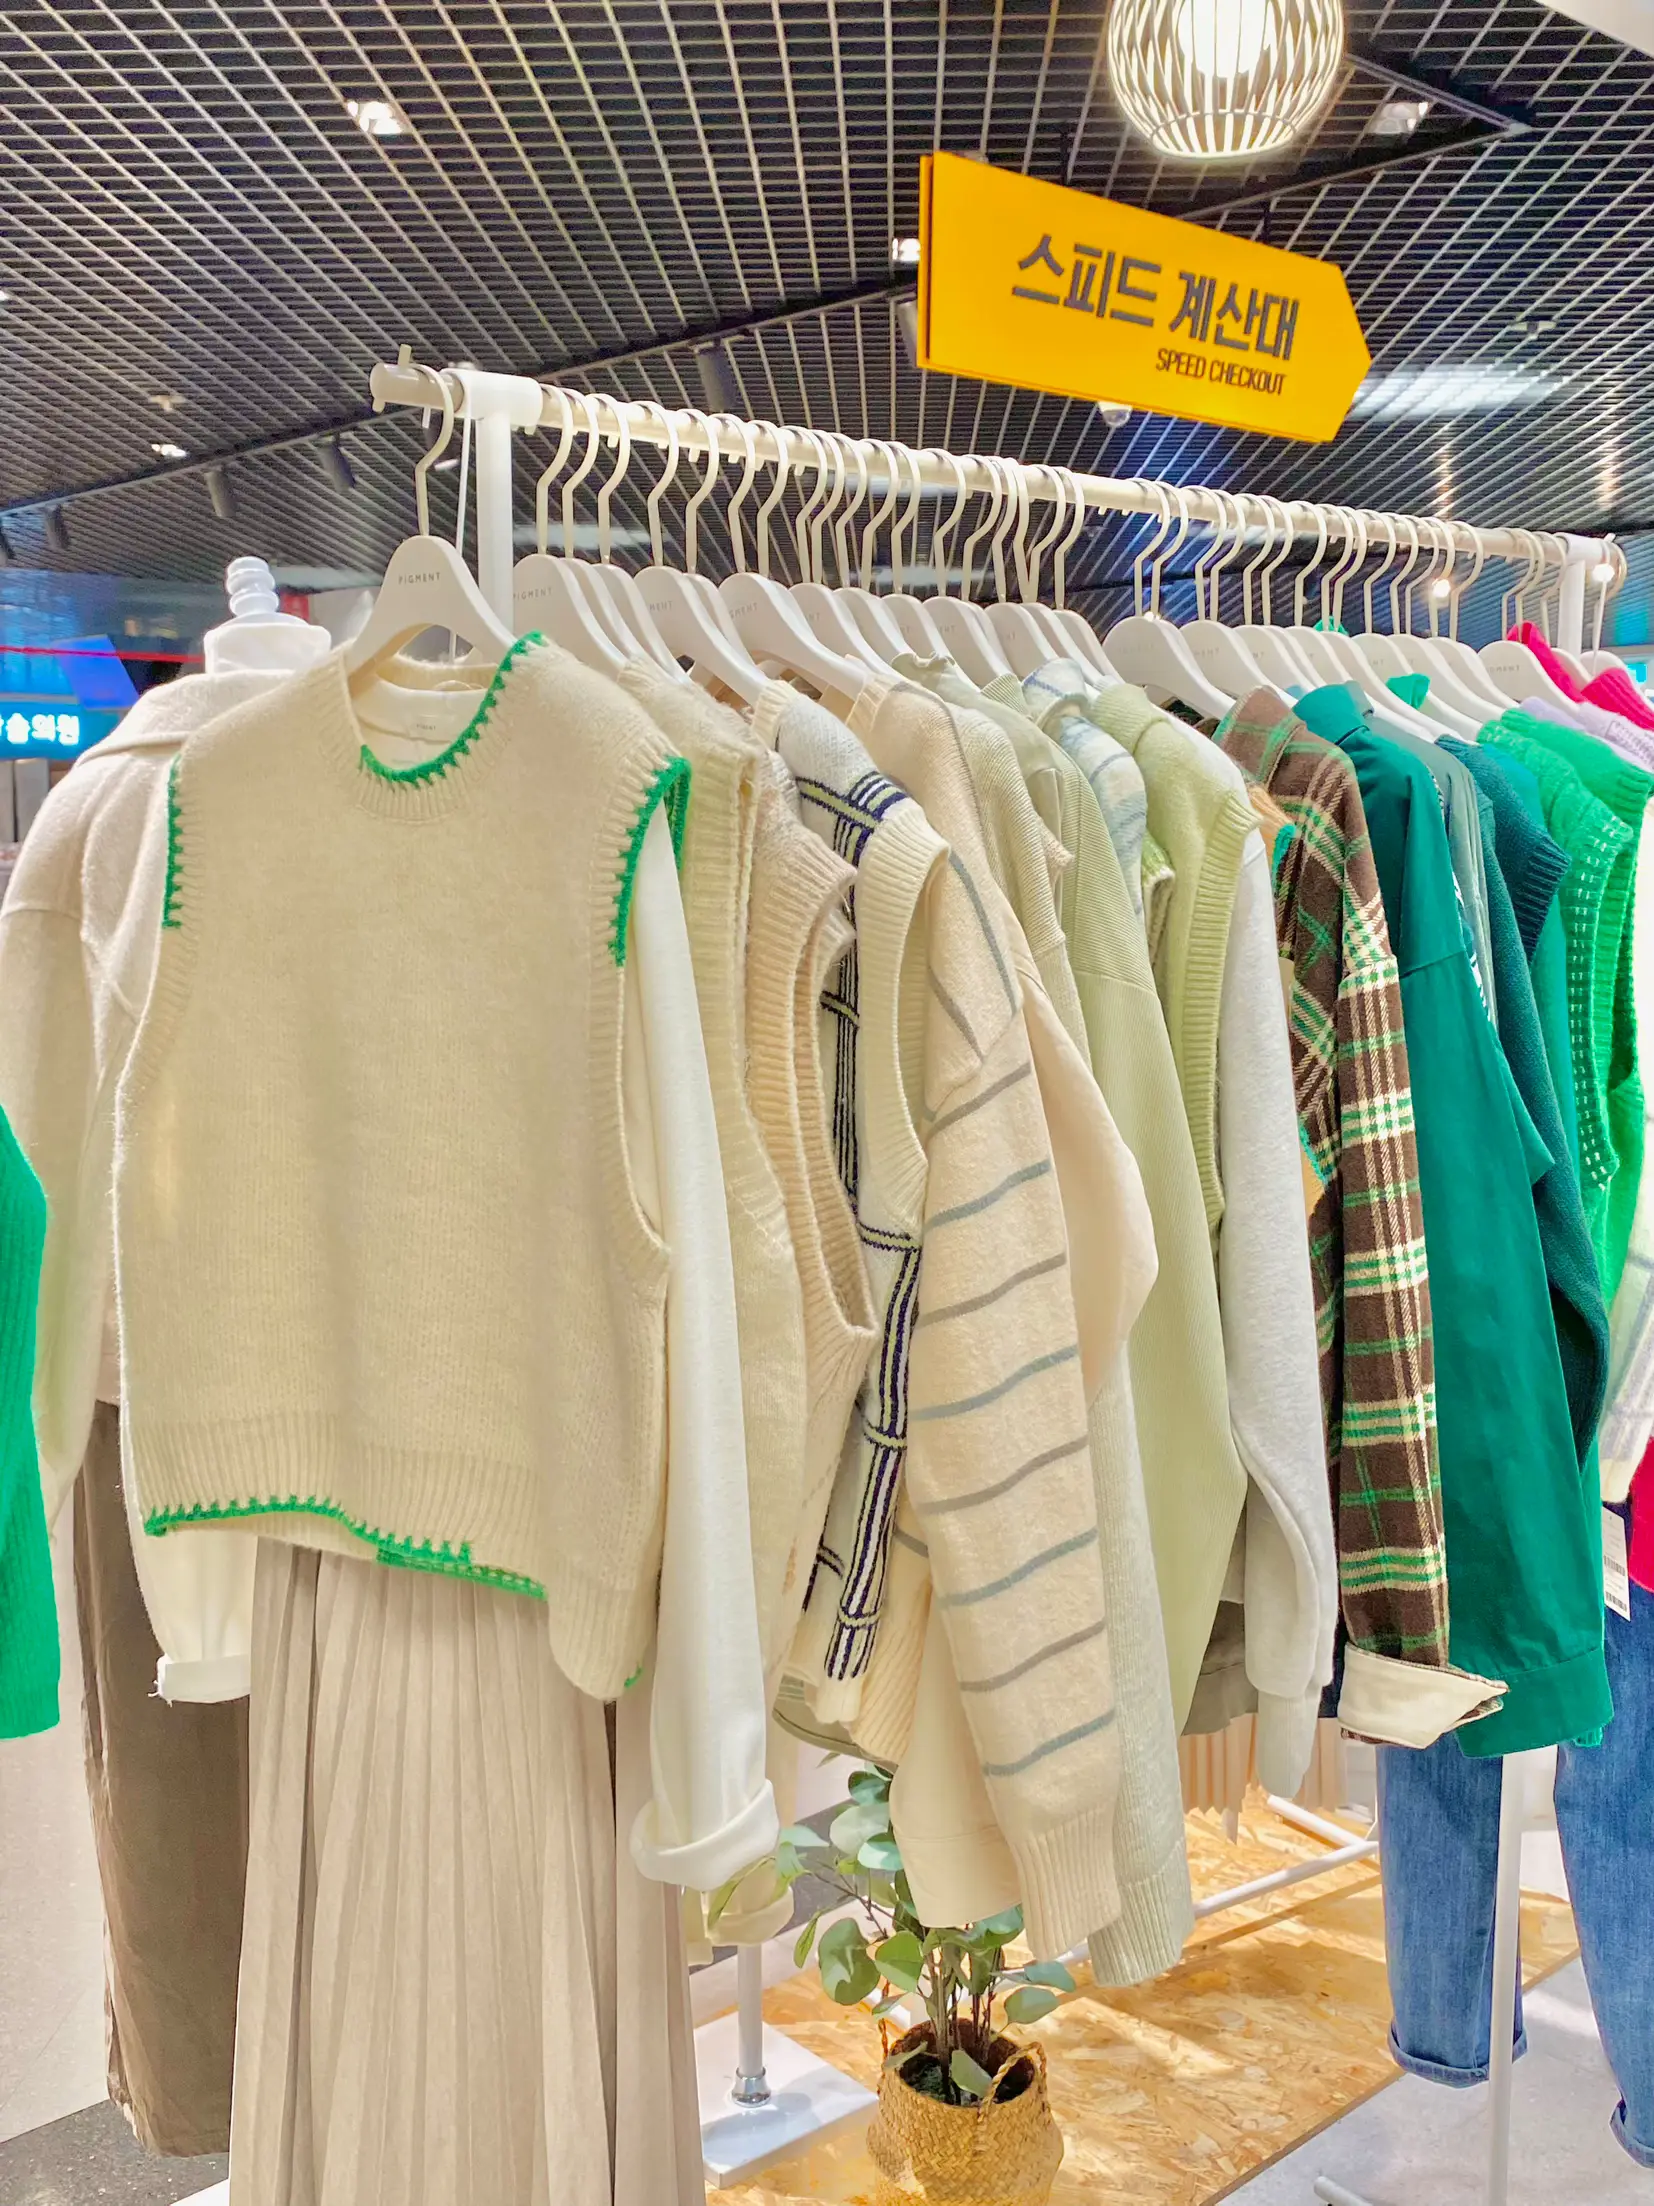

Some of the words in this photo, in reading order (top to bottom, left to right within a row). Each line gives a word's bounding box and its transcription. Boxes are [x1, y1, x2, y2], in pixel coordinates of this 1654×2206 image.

[1012, 234, 1161, 327] 스피드
[1169, 271, 1299, 361] 계산대
[1156, 348, 1206, 378] SPEED
[1209, 359, 1287, 396] CHECKOUT
[397, 572, 441, 585] PIGMENT
